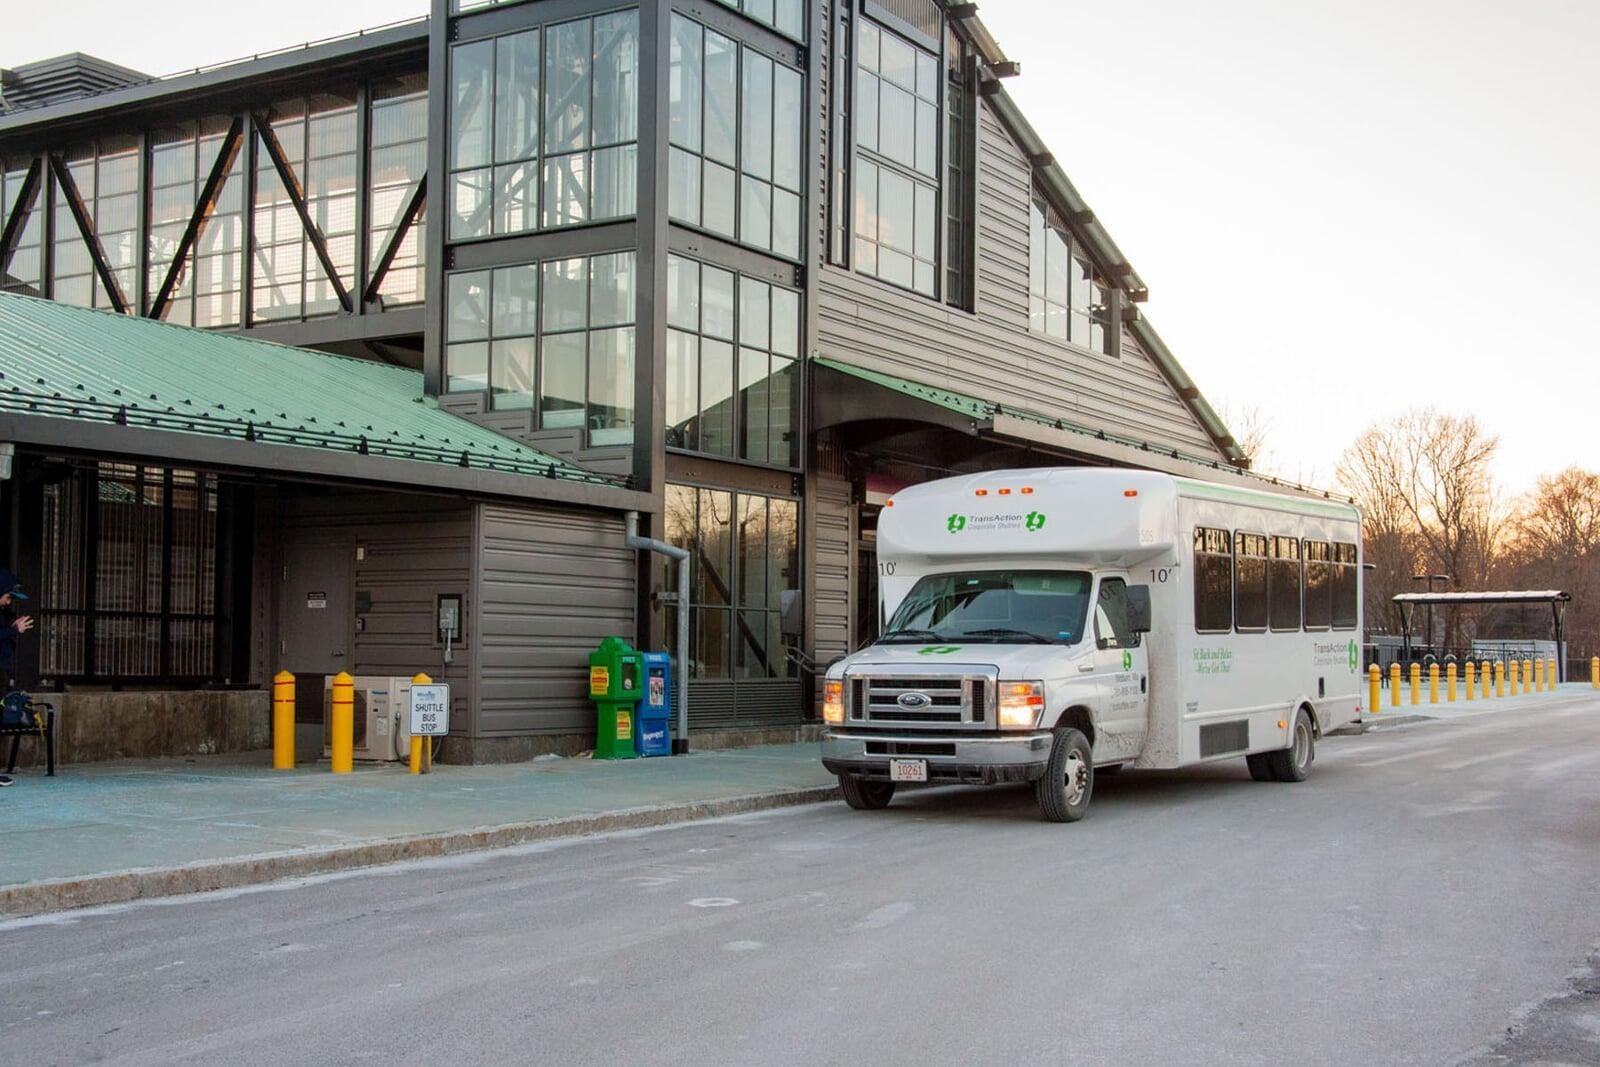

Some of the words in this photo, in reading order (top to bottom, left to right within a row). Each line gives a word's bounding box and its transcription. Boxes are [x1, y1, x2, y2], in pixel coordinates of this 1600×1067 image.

[970, 514, 1022, 522] TransAction
[1150, 568, 1172, 583] 10'
[1314, 642, 1347, 653] TransAction
[415, 704, 444, 712] SHUTTLE
[422, 713, 436, 722] BUS
[420, 723, 437, 732] STOP
